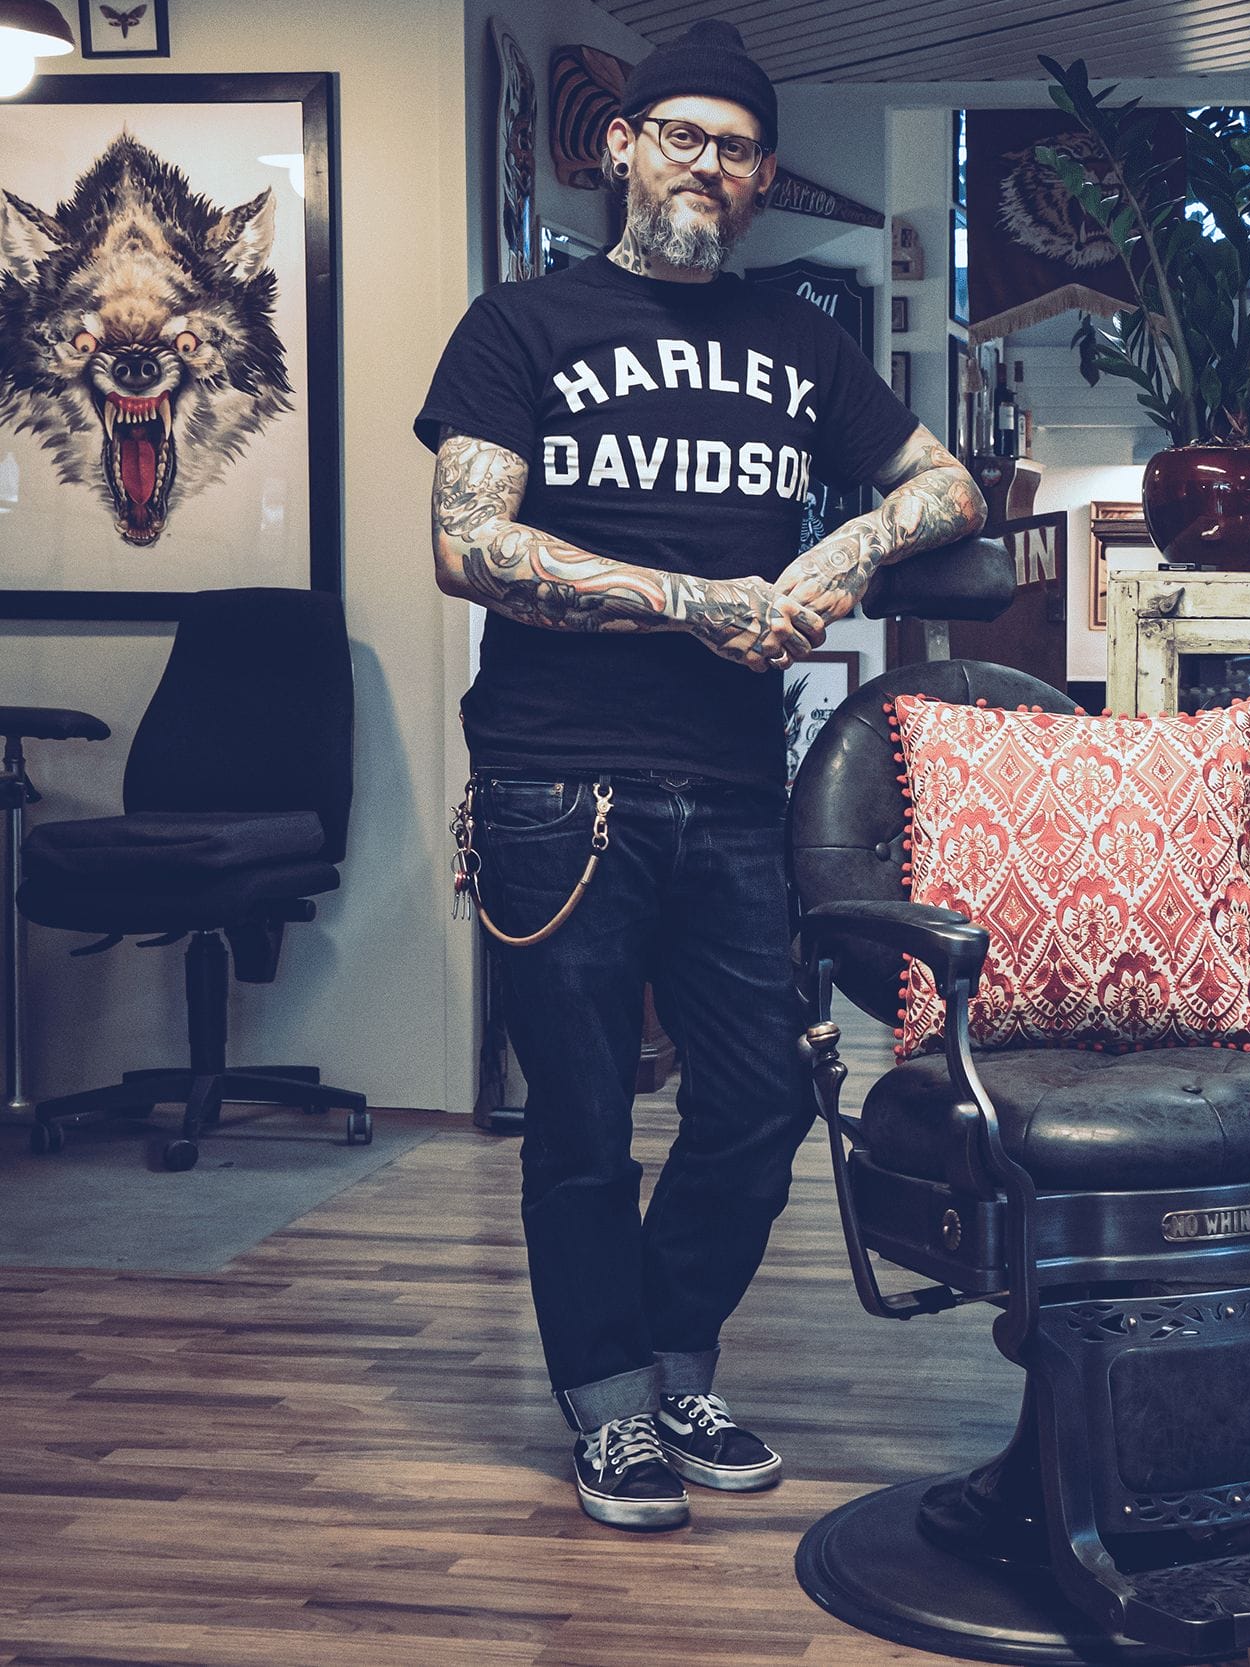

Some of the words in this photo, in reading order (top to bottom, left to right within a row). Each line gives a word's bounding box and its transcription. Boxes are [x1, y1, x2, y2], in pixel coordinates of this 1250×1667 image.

[771, 178, 836, 216] ATTOO
[553, 339, 817, 422] HARLEY-
[543, 434, 813, 503] DAVIDSON
[998, 526, 1057, 586] IN
[1170, 1215, 1199, 1237] NO
